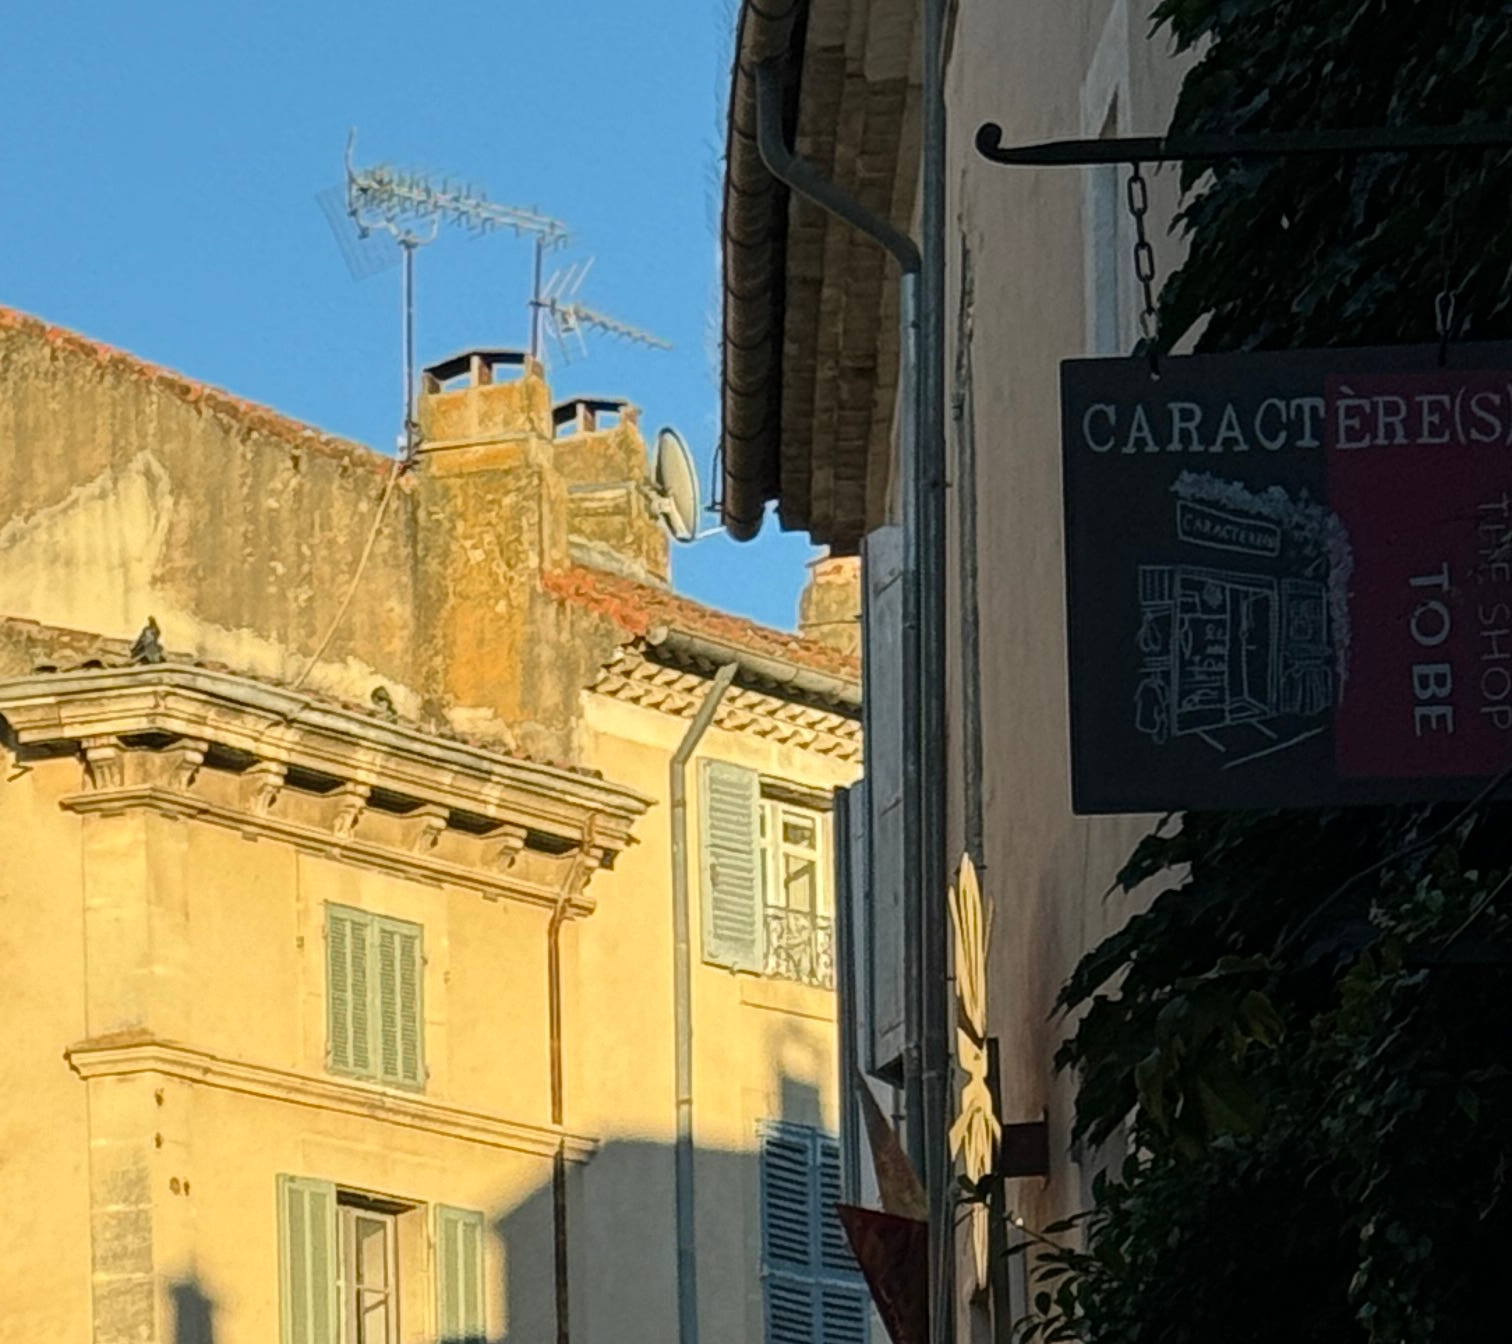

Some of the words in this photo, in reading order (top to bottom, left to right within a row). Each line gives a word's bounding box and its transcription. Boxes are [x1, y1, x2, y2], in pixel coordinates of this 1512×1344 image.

[1409, 562, 1451, 646] TO
[1412, 663, 1454, 737] BE
[1478, 602, 1512, 729] SHOP
